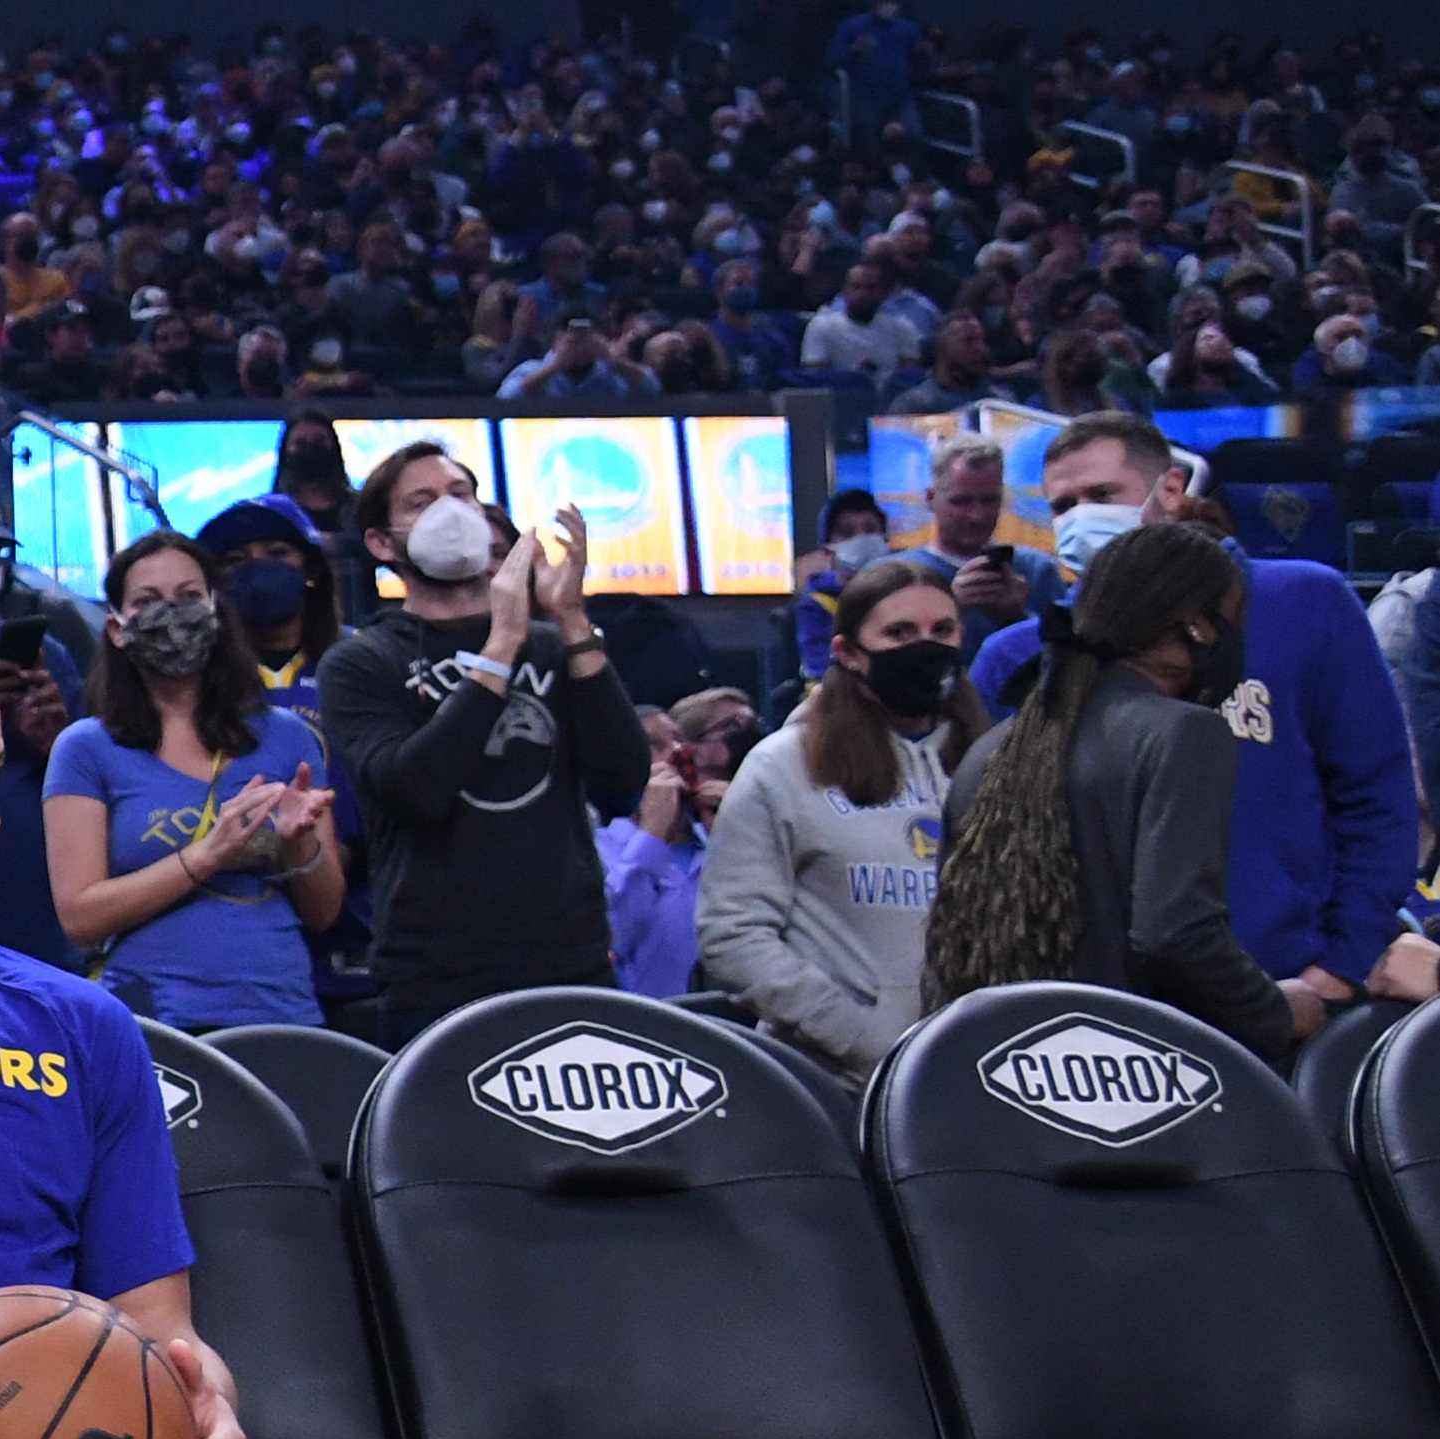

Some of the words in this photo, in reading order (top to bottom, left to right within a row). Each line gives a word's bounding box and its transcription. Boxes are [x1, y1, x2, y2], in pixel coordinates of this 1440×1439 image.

[405, 658, 555, 700] TON
[849, 864, 940, 906] WARR
[507, 1060, 697, 1112] CLOROX
[1012, 1053, 1192, 1103] CLOROX
